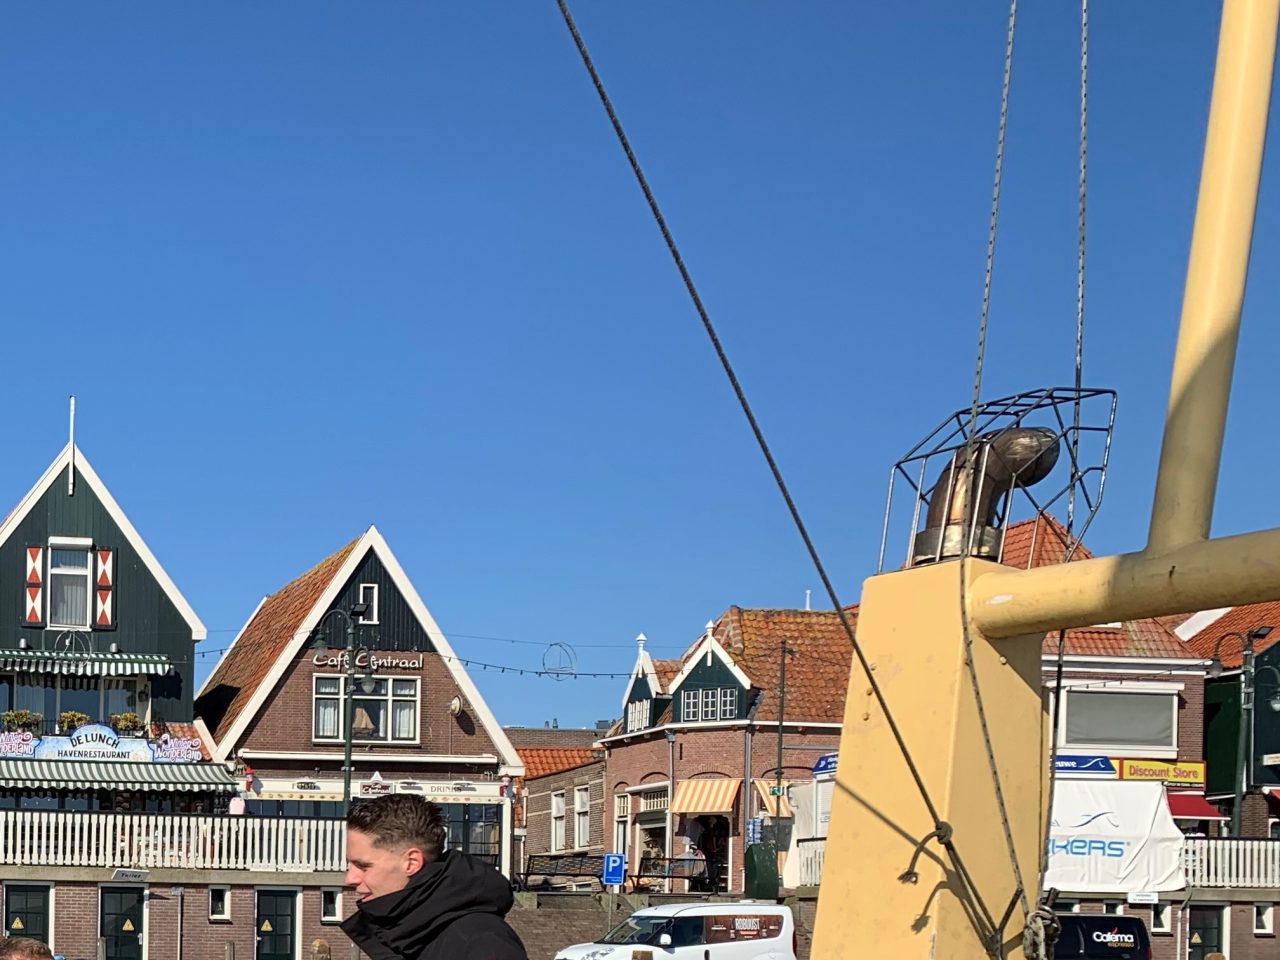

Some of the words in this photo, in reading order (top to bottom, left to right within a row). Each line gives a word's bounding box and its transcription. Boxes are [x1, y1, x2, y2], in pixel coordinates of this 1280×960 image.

[70, 735, 84, 747] DE
[85, 733, 120, 748] LUNCH
[57, 750, 130, 759] HAVENRESTAURANT
[1129, 764, 1169, 777] Discount
[1173, 767, 1199, 778] Store
[608, 856, 621, 872] P
